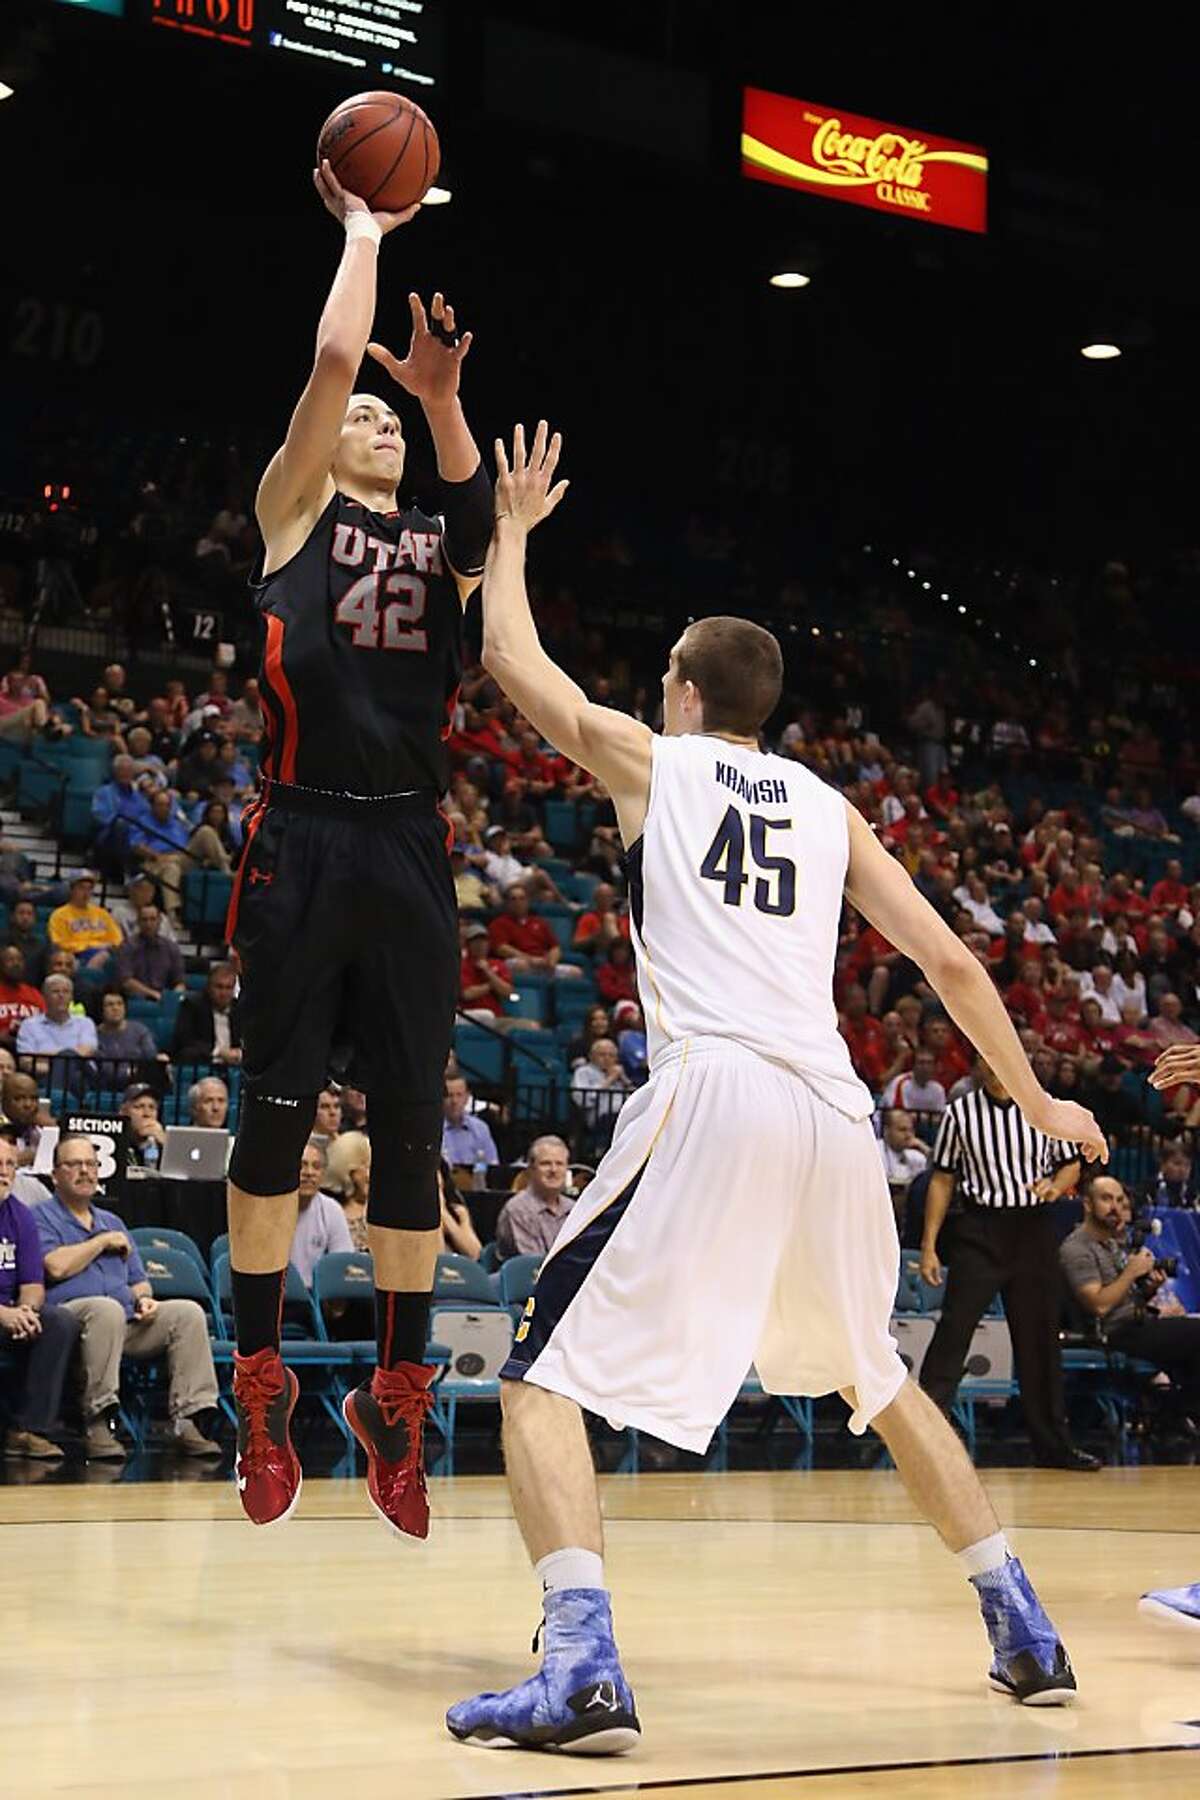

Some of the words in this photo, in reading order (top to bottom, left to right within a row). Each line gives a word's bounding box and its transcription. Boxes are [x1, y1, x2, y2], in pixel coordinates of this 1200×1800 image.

[876, 182, 932, 212] CLASSIC
[11, 296, 104, 367] 210
[332, 522, 443, 576] UTAH
[193, 614, 215, 639] 12
[335, 571, 428, 652] 42
[715, 760, 788, 805] KRAVISH
[700, 803, 796, 918] 45
[68, 1117, 123, 1133] SECTION
